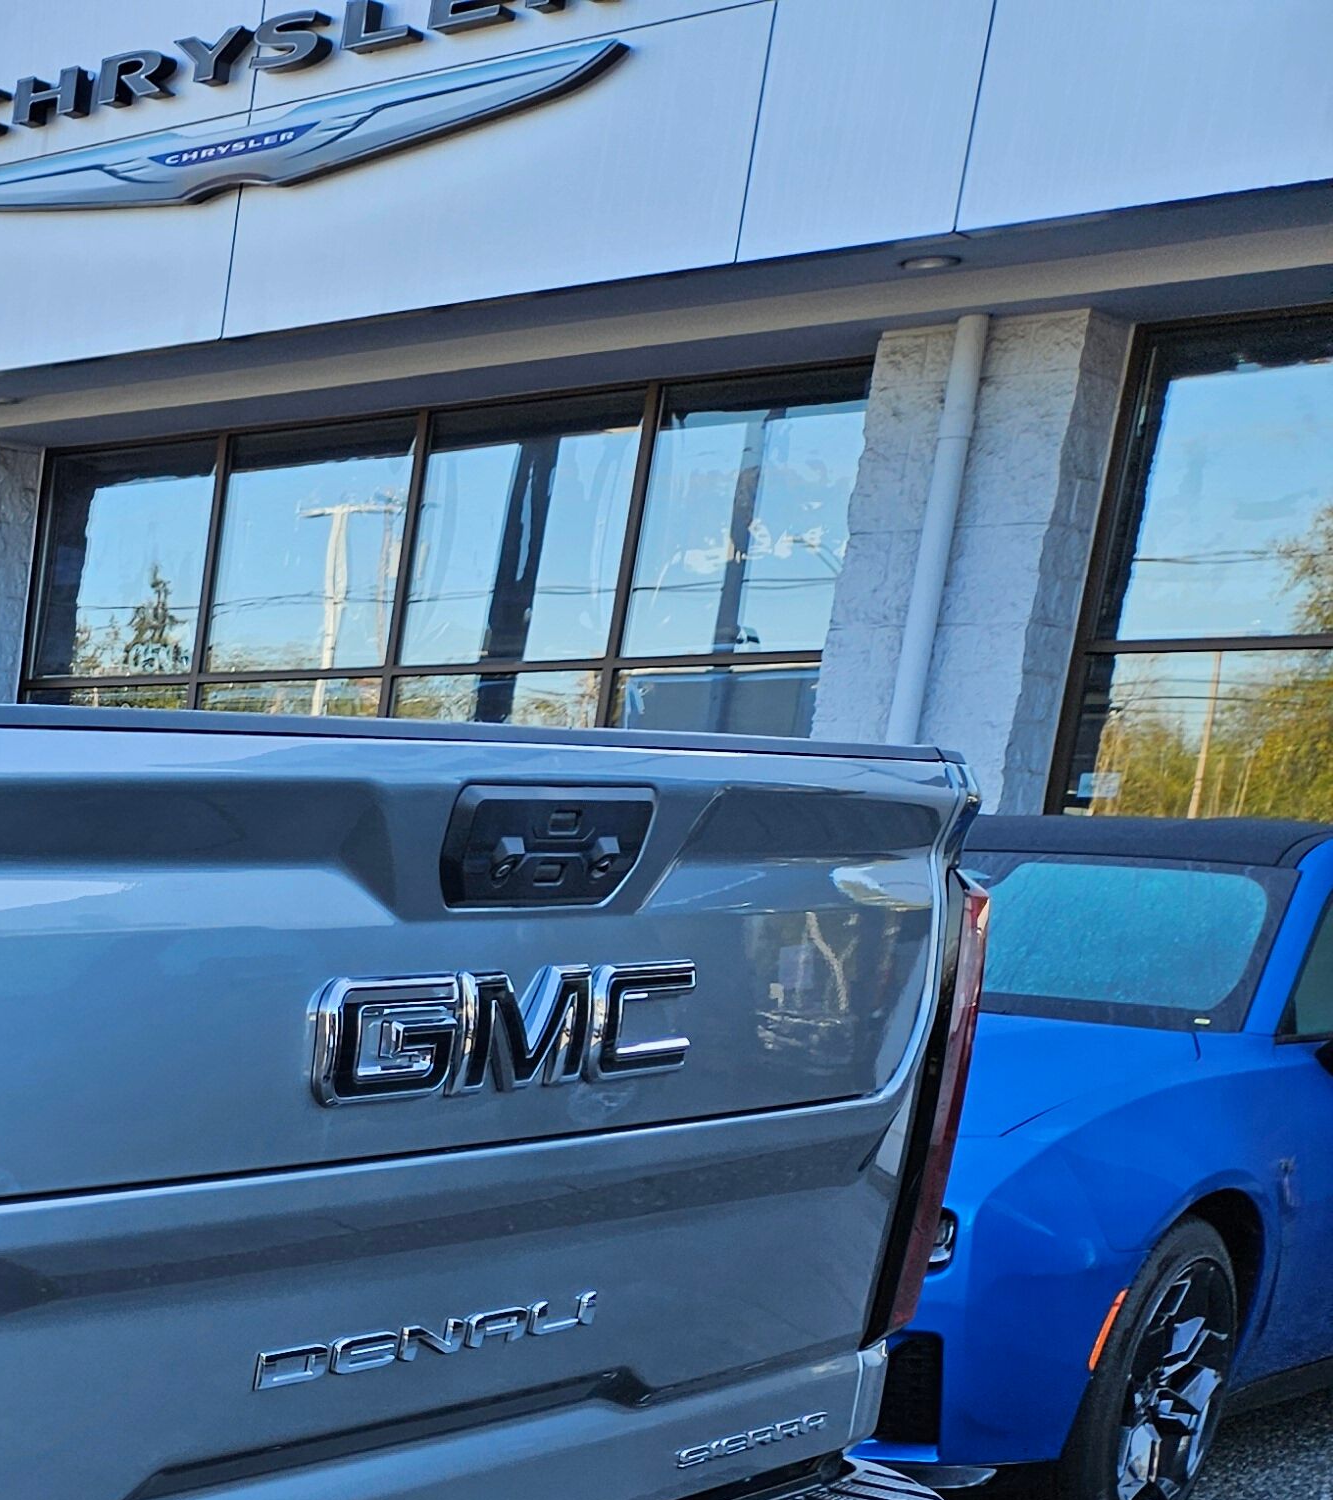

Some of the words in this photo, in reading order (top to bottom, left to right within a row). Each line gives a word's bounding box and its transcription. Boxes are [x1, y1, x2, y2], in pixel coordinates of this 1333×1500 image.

[164, 131, 296, 165] CHRYSLER
[307, 958, 697, 1107] GMC
[253, 1290, 598, 1391] DENALI
[676, 1411, 828, 1468] SIERRA
